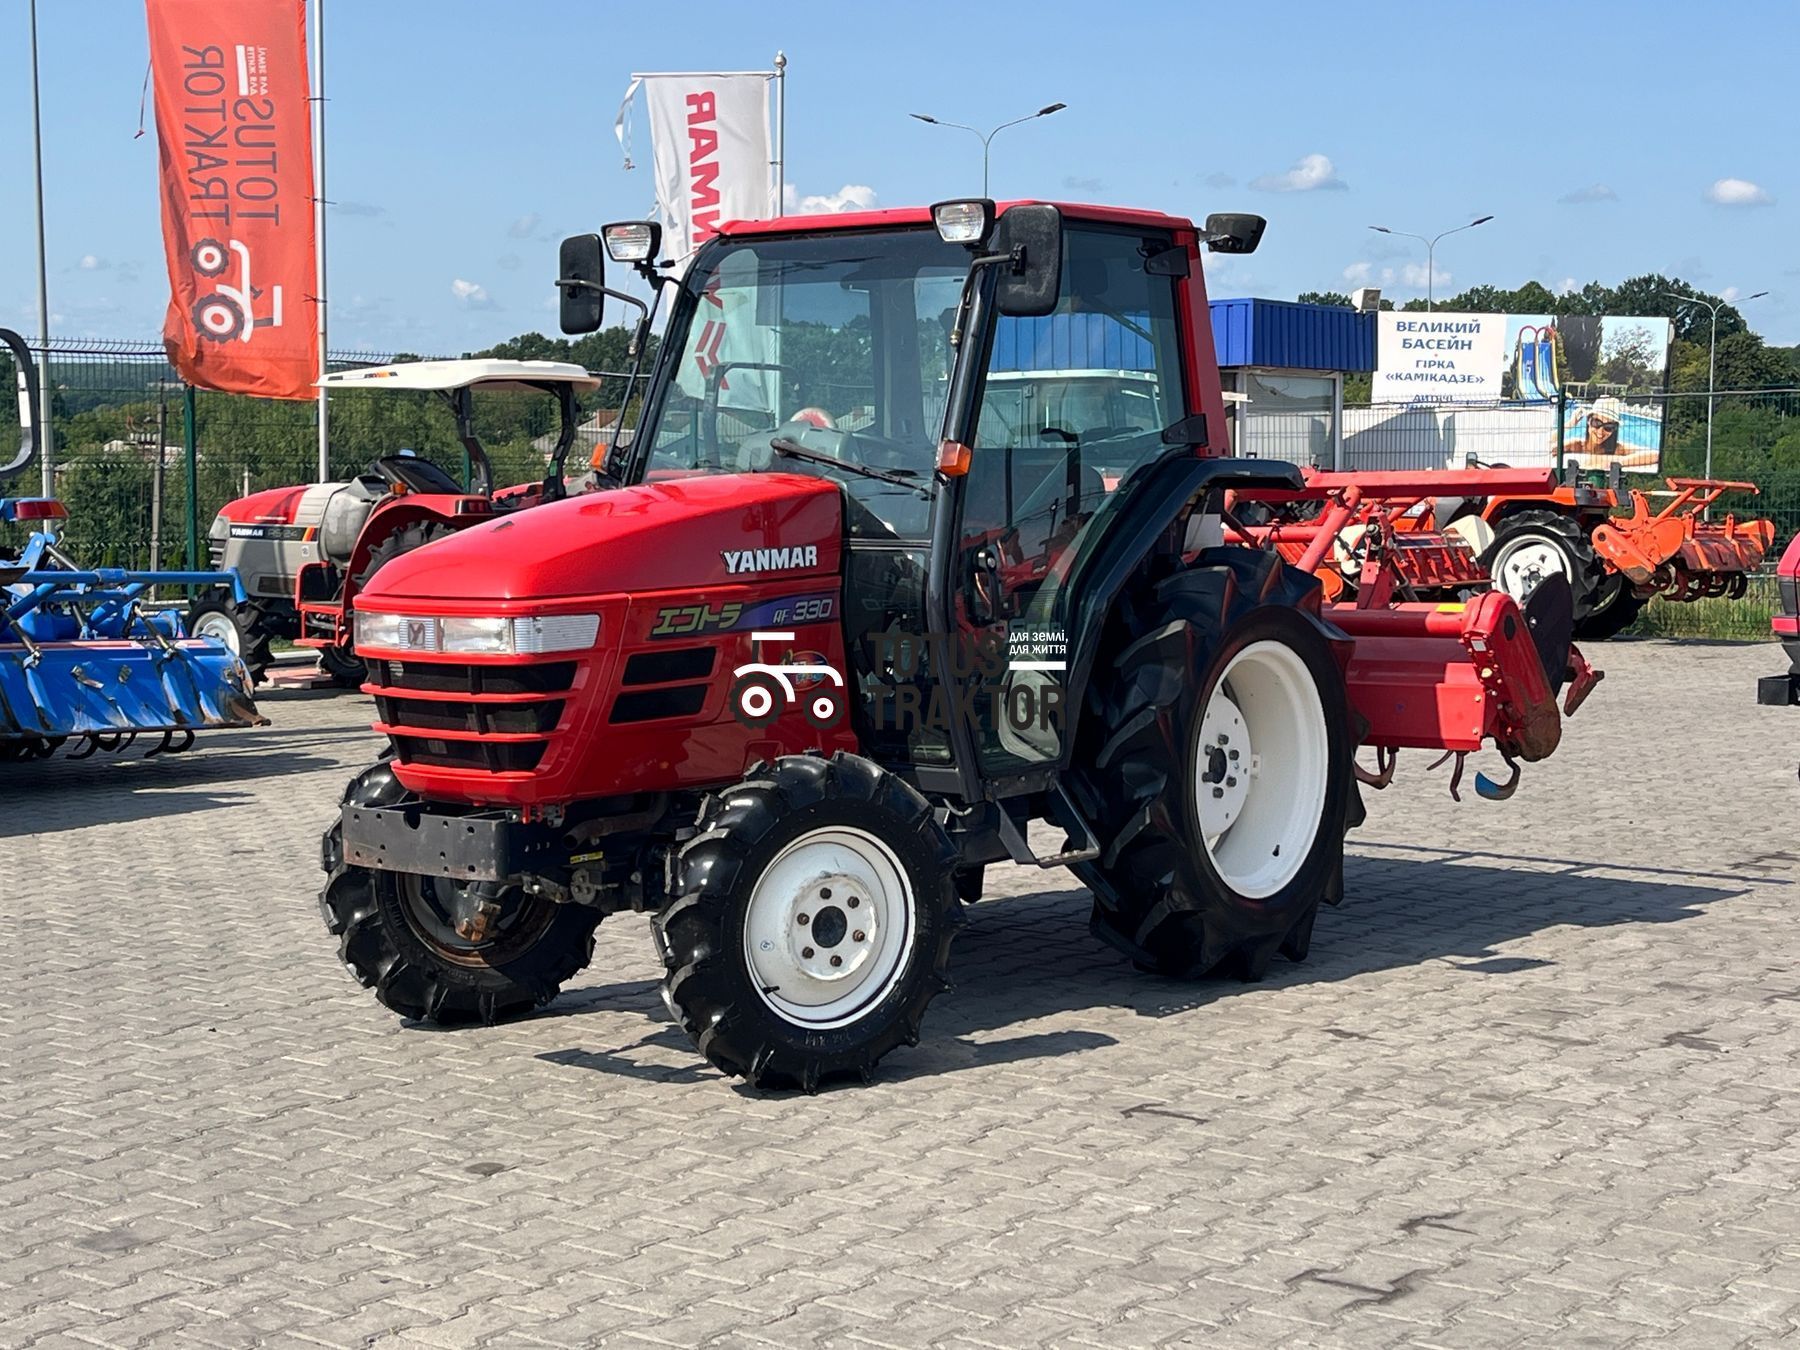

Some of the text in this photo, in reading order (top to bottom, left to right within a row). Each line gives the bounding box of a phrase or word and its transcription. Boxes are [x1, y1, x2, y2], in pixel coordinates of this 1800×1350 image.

[1396, 318, 1481, 334] ВЕЛИКИЙ
[1402, 335, 1473, 351] БАСЕЙН
[1415, 359, 1456, 370] ГІРКА
[1385, 372, 1486, 385] «КАМІКАДЗЕ»
[723, 545, 818, 574] YANMAR
[792, 599, 833, 621] 330
[652, 603, 743, 635] エコトラ
